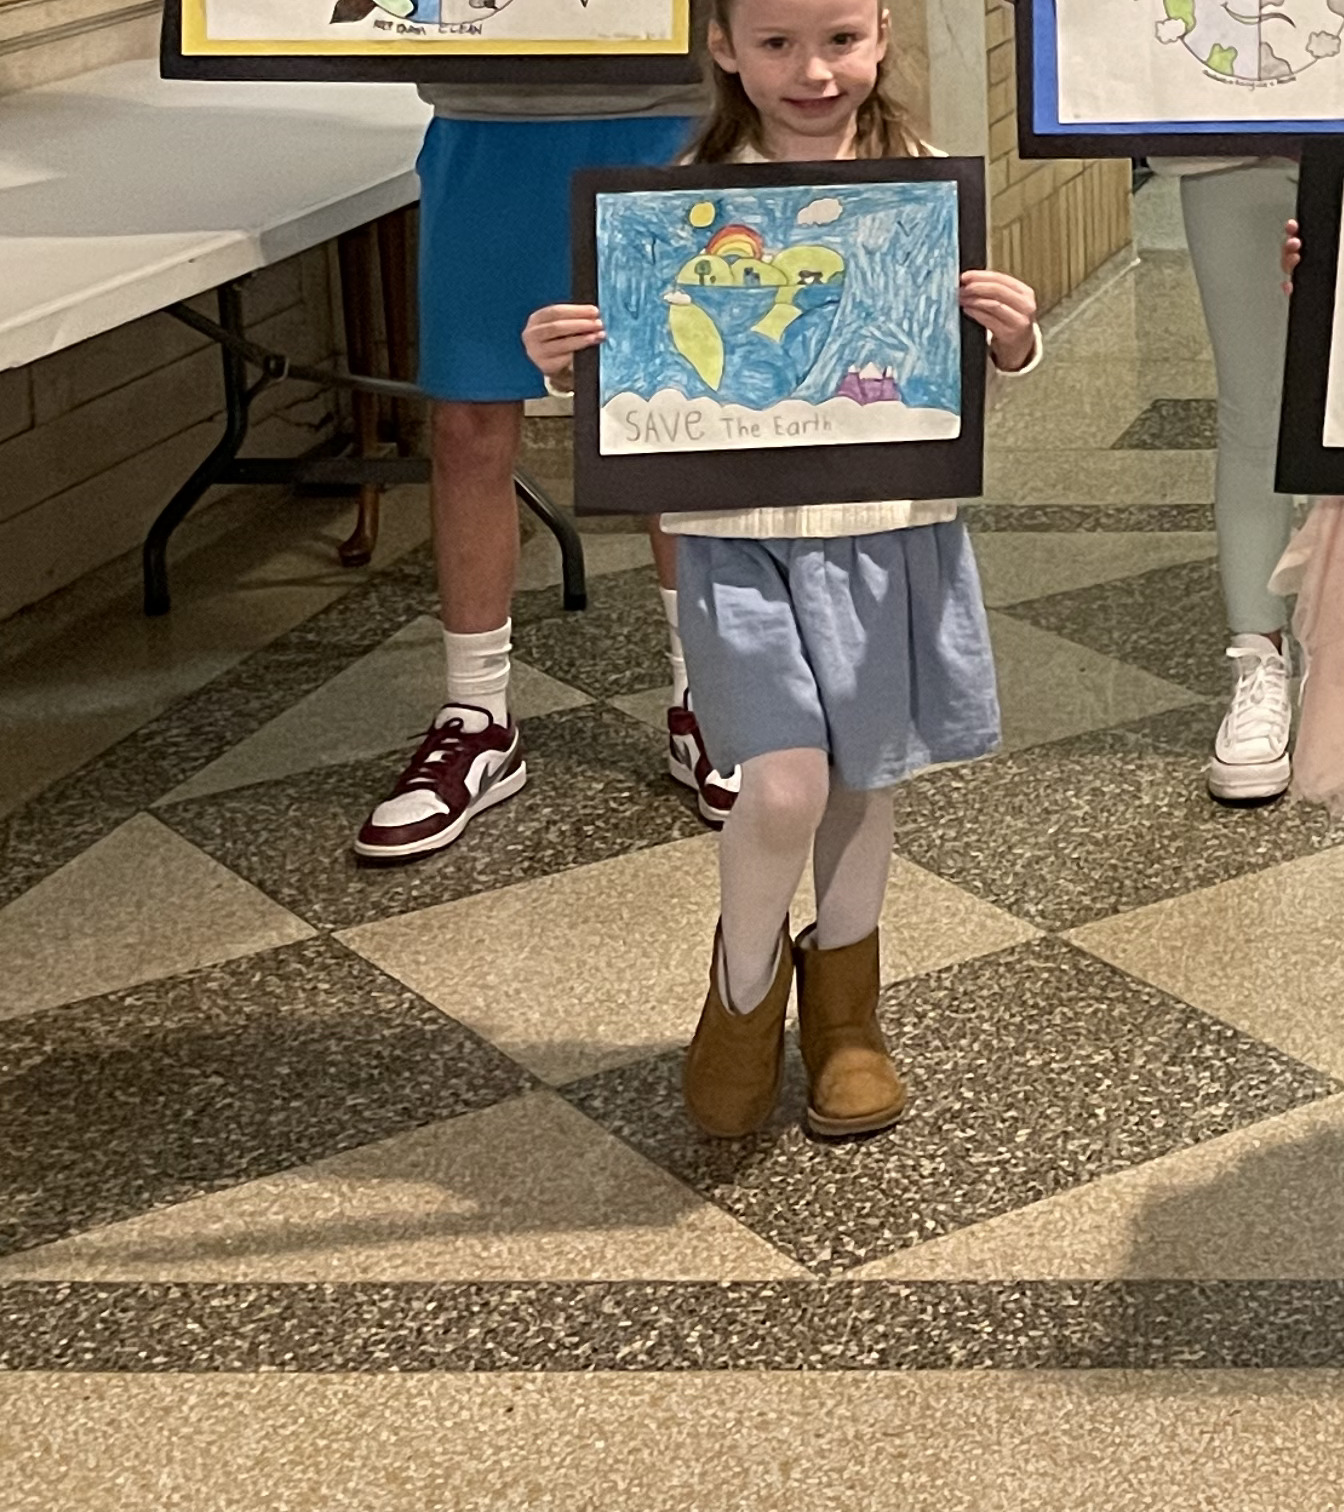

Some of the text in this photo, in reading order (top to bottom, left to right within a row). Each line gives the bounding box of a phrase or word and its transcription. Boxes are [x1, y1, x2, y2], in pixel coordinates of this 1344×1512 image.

[438, 23, 482, 35] CLEAN
[720, 417, 760, 438] The
[773, 412, 832, 436] Earth
